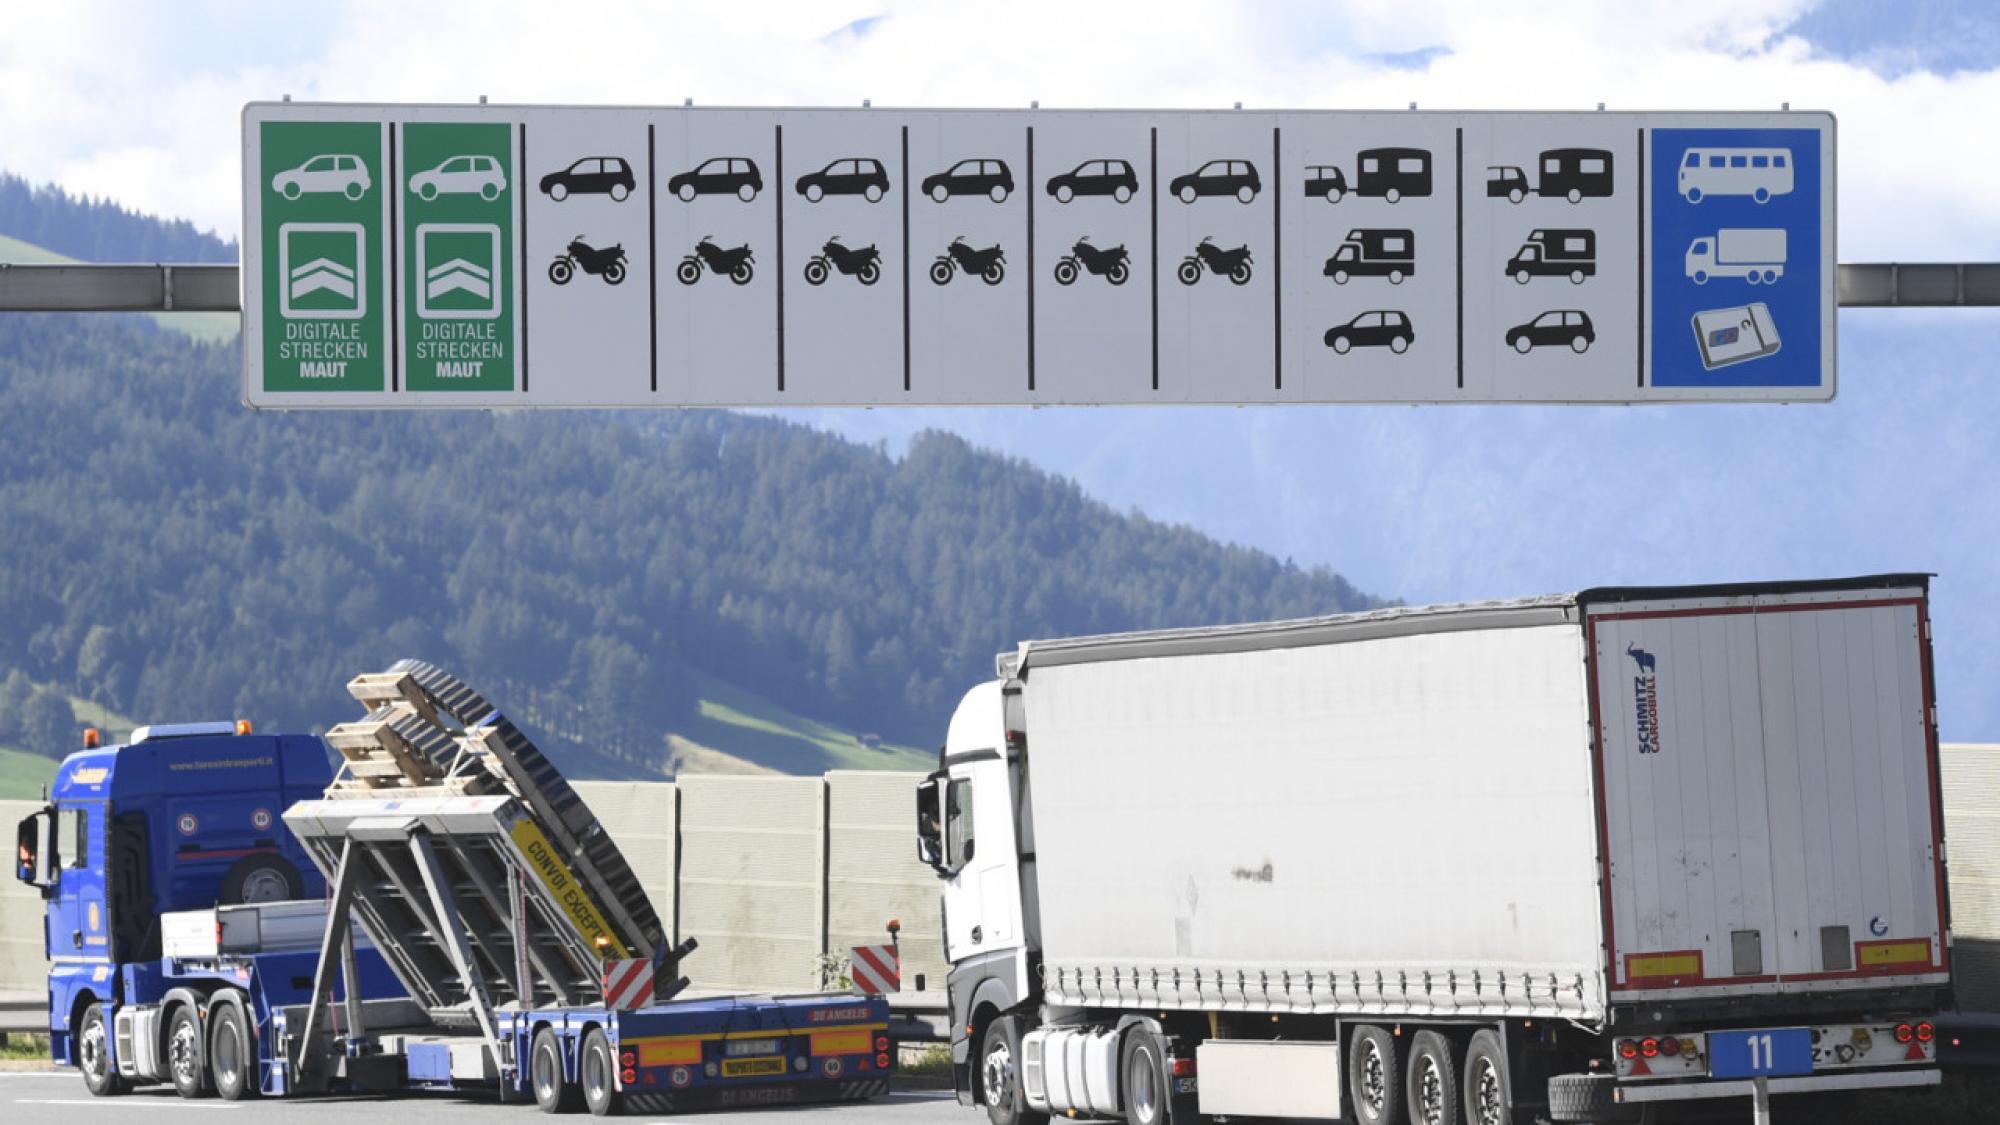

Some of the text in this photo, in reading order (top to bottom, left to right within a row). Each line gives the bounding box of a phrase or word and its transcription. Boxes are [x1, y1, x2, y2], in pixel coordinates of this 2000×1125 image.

[286, 323, 361, 340] DIGITALE
[422, 323, 496, 340] DIGITALE
[280, 342, 368, 360] STRECKEN
[416, 342, 503, 360] STRECKEN
[299, 362, 348, 378] MAUT
[436, 362, 483, 378] MAUT
[1635, 676, 1651, 754] SCHMITZ
[1646, 675, 1660, 754] CARGOBULL
[528, 841, 567, 890] CONVOI
[1747, 1035, 1773, 1070] 11
